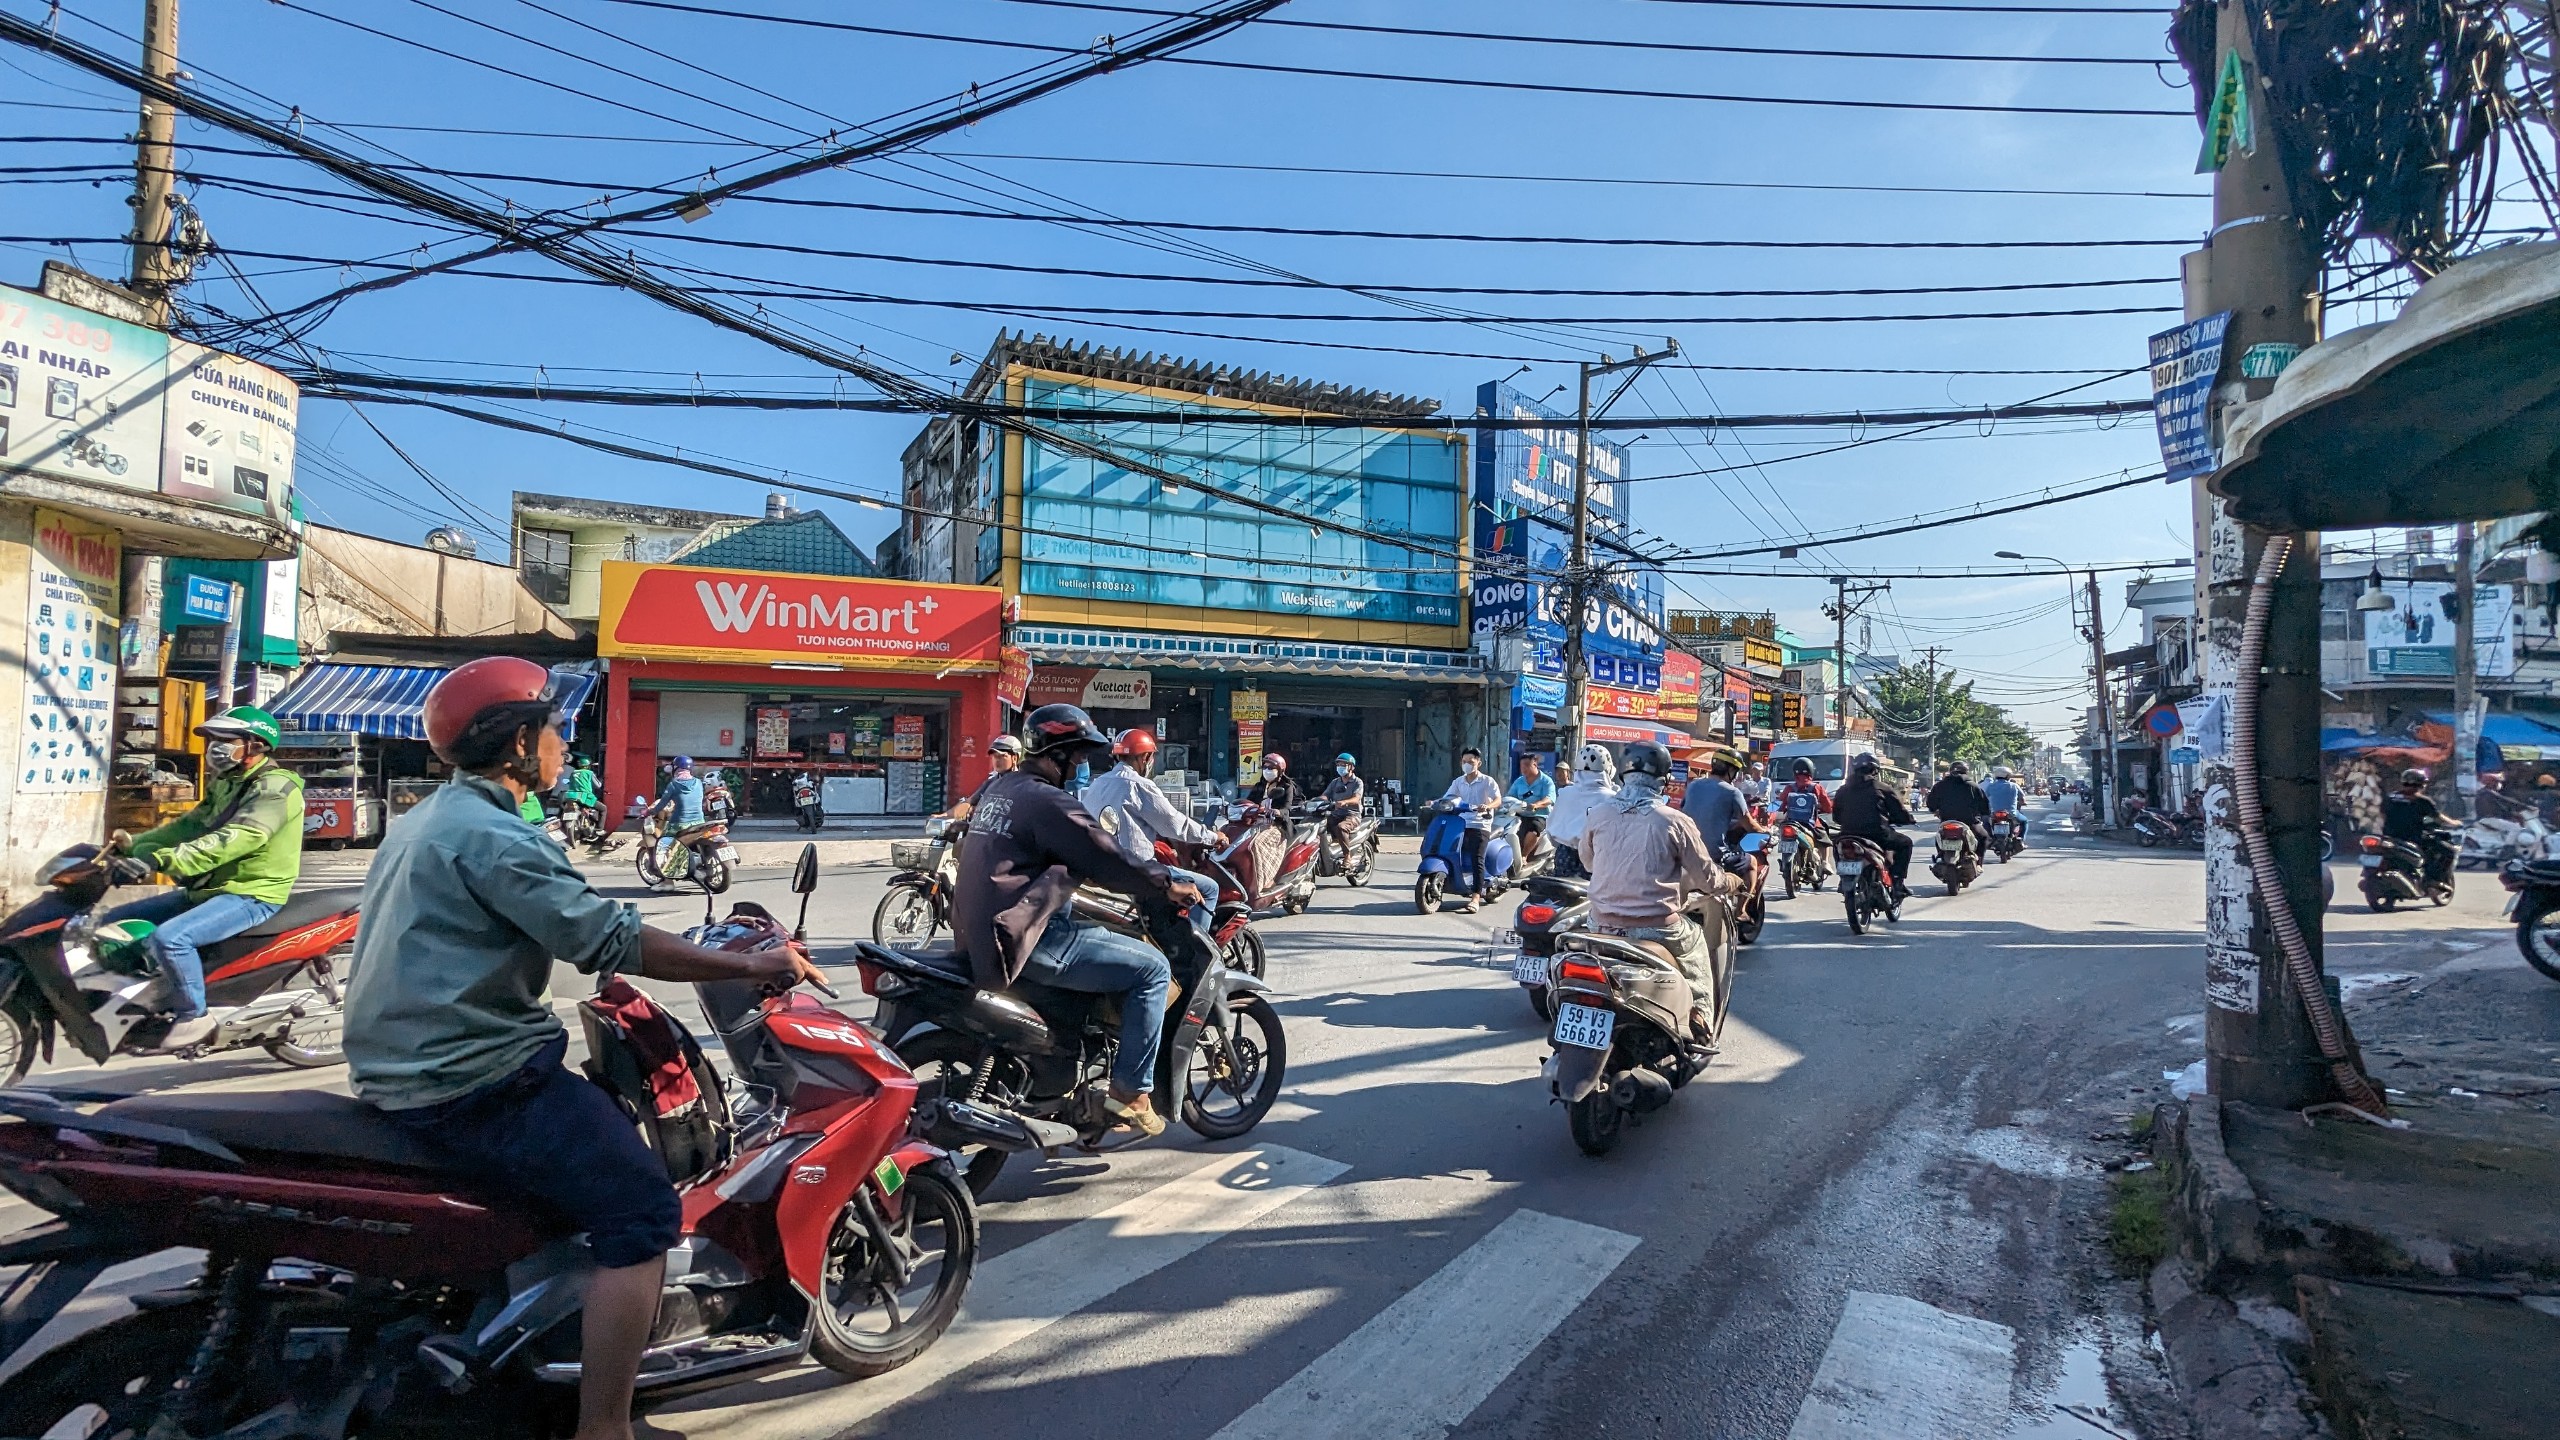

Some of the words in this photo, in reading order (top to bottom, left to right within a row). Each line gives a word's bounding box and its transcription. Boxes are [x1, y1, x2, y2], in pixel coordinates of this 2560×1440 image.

[42, 312, 113, 353] 389
[39, 348, 111, 379] NHẬP
[193, 363, 224, 387] CỬA
[228, 374, 264, 399] HÀNG
[266, 387, 289, 411] KHÓA
[191, 389, 250, 415] CHUYÊN
[253, 407, 275, 424] BÁN
[277, 417, 291, 432] CÁC
[1553, 459, 1571, 489] FPT
[40, 571, 58, 585] LÀM
[200, 583, 224, 597] ĐƯỜNG
[1281, 590, 1336, 609] Website:
[1474, 582, 1526, 608] LONG
[695, 580, 939, 635] WinMart+
[1606, 594, 1661, 647] CHÂU
[797, 634, 826, 646] TƯƠI
[828, 636, 863, 648] NGON
[865, 638, 914, 652] THƯỢNG
[916, 640, 951, 653] HẠNG!
[1039, 673, 1051, 684] SỐ
[1093, 681, 1132, 693] Vietlott
[1513, 968, 1544, 982] 801.92
[1518, 957, 1542, 971] 77-E1
[1567, 1006, 1607, 1028] 59-V3
[1560, 1023, 1606, 1047] 566.82
